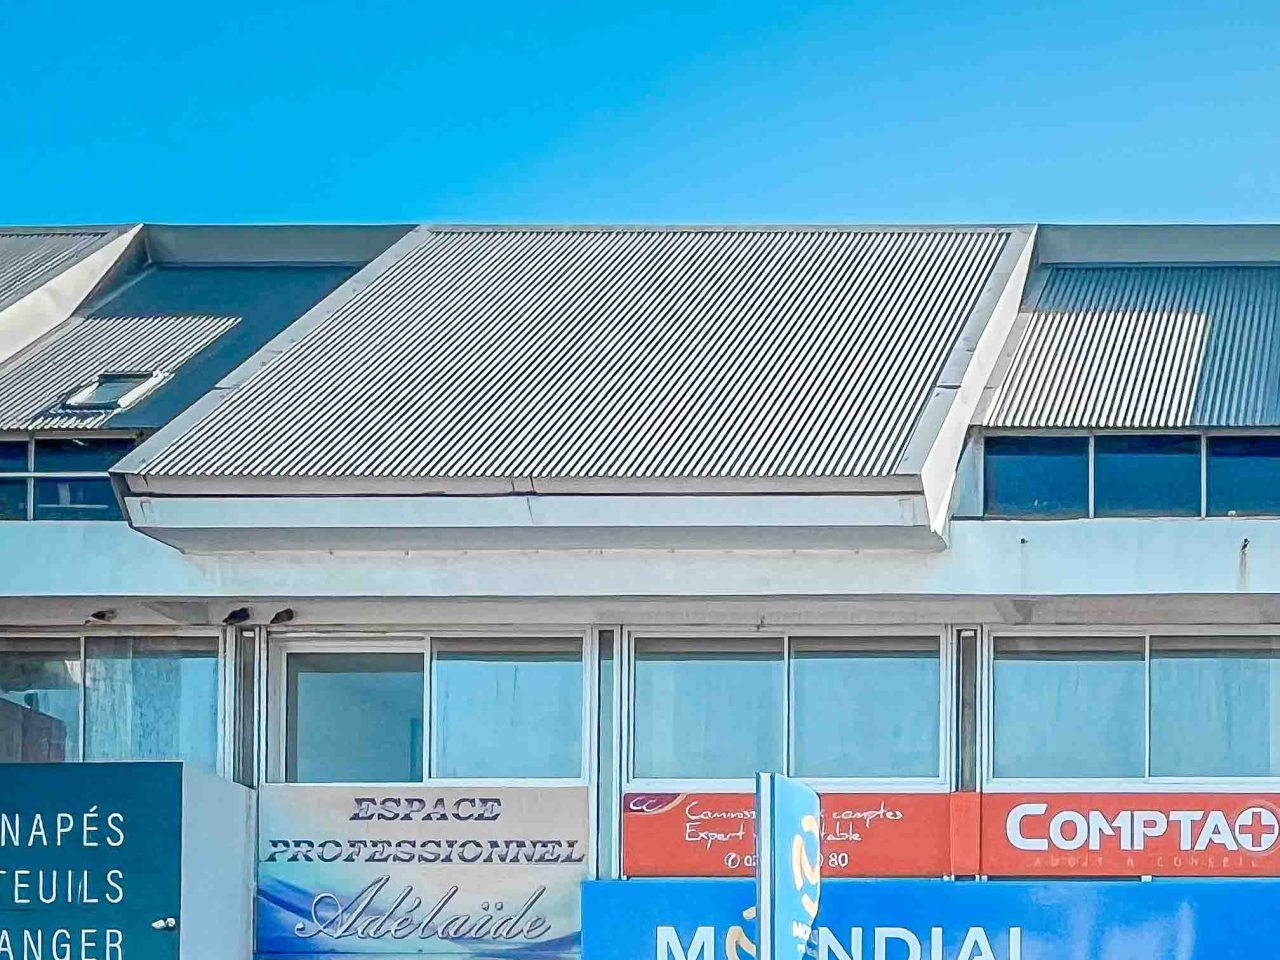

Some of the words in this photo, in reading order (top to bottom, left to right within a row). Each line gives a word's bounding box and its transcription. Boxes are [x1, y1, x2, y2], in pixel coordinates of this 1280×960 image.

[349, 797, 502, 821] ESPACE
[0, 805, 125, 847] NAPÉS
[686, 822, 746, 850] Expert
[262, 839, 586, 864] PROFESSIONNEL
[294, 875, 552, 940] Adélaïde
